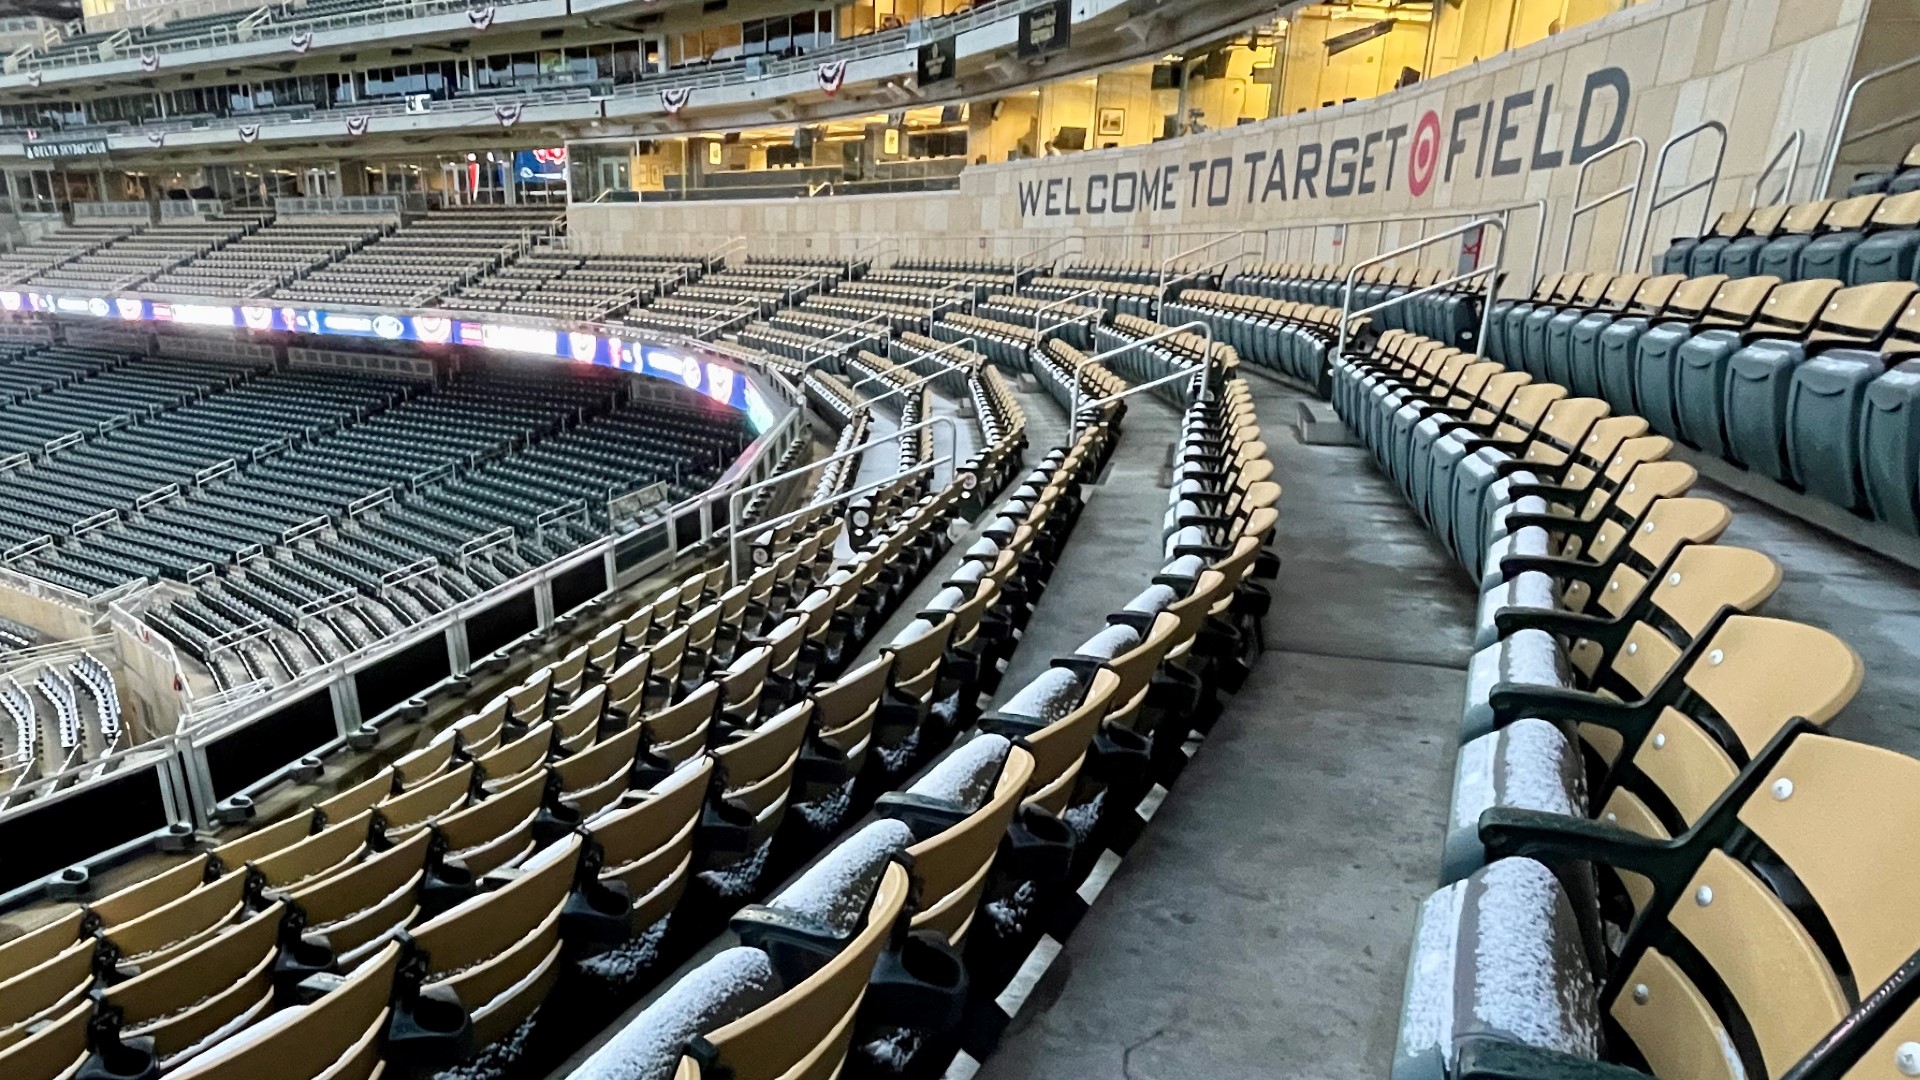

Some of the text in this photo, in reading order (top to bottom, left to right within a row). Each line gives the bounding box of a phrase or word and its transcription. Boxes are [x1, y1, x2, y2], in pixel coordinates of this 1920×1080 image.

[32, 145, 59, 158] DELTA
[1018, 66, 1630, 218] WELCOME TO TARGET FIELD
